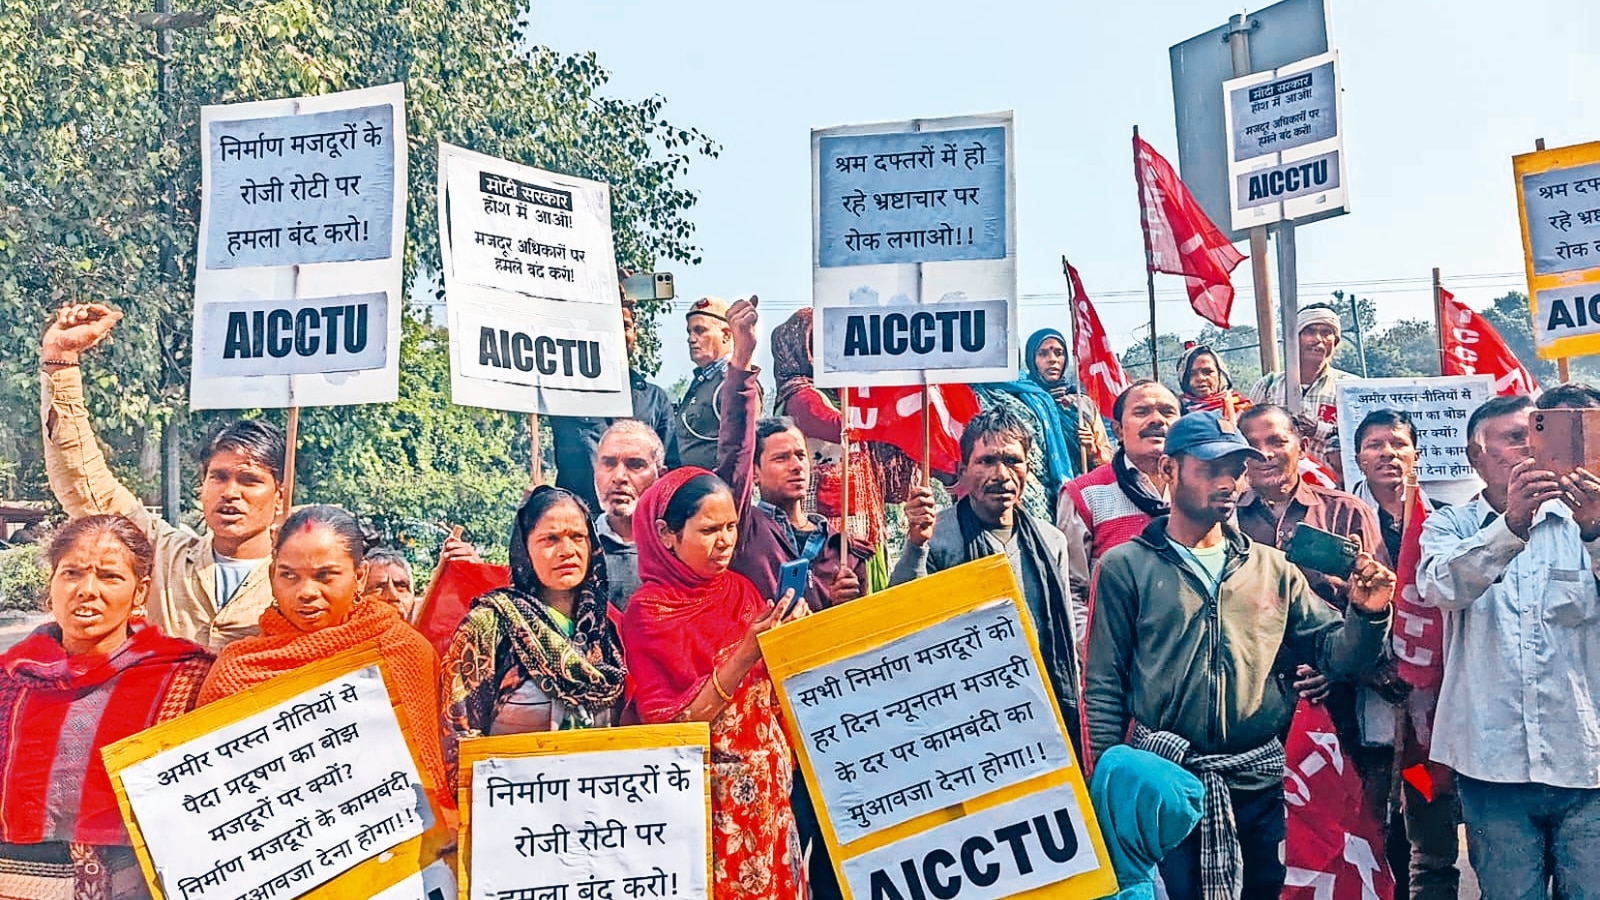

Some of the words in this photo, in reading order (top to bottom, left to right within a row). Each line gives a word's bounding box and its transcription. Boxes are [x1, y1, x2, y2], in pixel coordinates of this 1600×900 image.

[1309, 109, 1320, 118] पर
[220, 133, 285, 162] निर्माण
[290, 123, 358, 158] मजदूरों
[363, 121, 383, 148] के
[835, 156, 867, 173] श्रम
[941, 144, 957, 167] में
[963, 142, 986, 170] हो
[240, 175, 284, 205] रोजी
[290, 173, 329, 202] रोटी
[335, 175, 361, 196] पर
[485, 176, 518, 197] मोदी
[521, 186, 569, 208] सरकार
[1249, 159, 1327, 201] AICCTU
[1539, 183, 1568, 199] श्रम
[483, 196, 510, 216] होश
[516, 202, 528, 219] में
[841, 189, 867, 217] रहे
[873, 189, 948, 211] भ्रष्टाचार
[953, 187, 980, 205] पर
[1549, 210, 1572, 232] रहे
[227, 228, 282, 255] हमला
[287, 223, 317, 246] बंद
[324, 215, 369, 244] करो!
[475, 231, 512, 257] मजदूर
[518, 238, 566, 259] अधिकारों
[570, 249, 586, 263] पर
[845, 228, 880, 251] रोक
[887, 222, 973, 249] लगाओ!!
[1556, 241, 1588, 260] रोक
[494, 257, 523, 274] हमले
[223, 304, 369, 359] AICCTU
[844, 310, 986, 356] AICCTU
[479, 326, 601, 378] AICCTU
[1359, 392, 1386, 403] अमीर
[1390, 394, 1417, 403] परस्त
[1420, 388, 1457, 402] नीतियों
[1461, 388, 1471, 399] से
[1426, 411, 1440, 420] का
[1443, 407, 1466, 419] बोझ
[1426, 464, 1446, 475] देना
[1431, 445, 1441, 456] के
[798, 676, 843, 708] सभी
[845, 654, 912, 692] निर्माण
[914, 627, 983, 664] मजदूरों
[986, 616, 1016, 642] को
[811, 725, 840, 753] हर
[841, 708, 881, 738] दिन
[883, 683, 958, 723] न्यूनतम
[961, 657, 1031, 694] मजदूरी
[157, 750, 214, 787] अमीर
[215, 725, 271, 759] परस्त
[273, 691, 337, 734] नीतियों
[339, 683, 360, 704] से
[835, 761, 857, 785] के
[860, 753, 889, 778] दर
[890, 741, 919, 765] पर
[921, 710, 1002, 752] कामबंदी
[1005, 701, 1034, 724] का
[181, 788, 222, 816] पैदा
[225, 756, 287, 797] प्रदूषण
[288, 742, 317, 765] का
[319, 722, 360, 750] बोझ
[487, 773, 570, 807] निर्माण
[578, 764, 660, 803] मजदूरों
[666, 763, 691, 791] के
[848, 779, 933, 828] मुआवजा
[937, 766, 976, 792] देना
[978, 742, 1048, 784] होगा!!
[208, 797, 275, 843] मजदूरों
[277, 787, 304, 808] पर
[306, 763, 354, 796] क्यों?
[178, 860, 245, 900] निर्माण
[248, 817, 313, 860] मजदूरों
[315, 809, 336, 829] के
[338, 772, 412, 818] कामबंदी
[316, 840, 354, 866] देना
[355, 808, 414, 853] होगा!!
[514, 824, 570, 857] रोजी
[578, 819, 627, 851] रोटी
[635, 823, 667, 846] पर
[870, 808, 1078, 900] AICCTU
[577, 875, 615, 900] बंद
[622, 866, 678, 899] करो!
